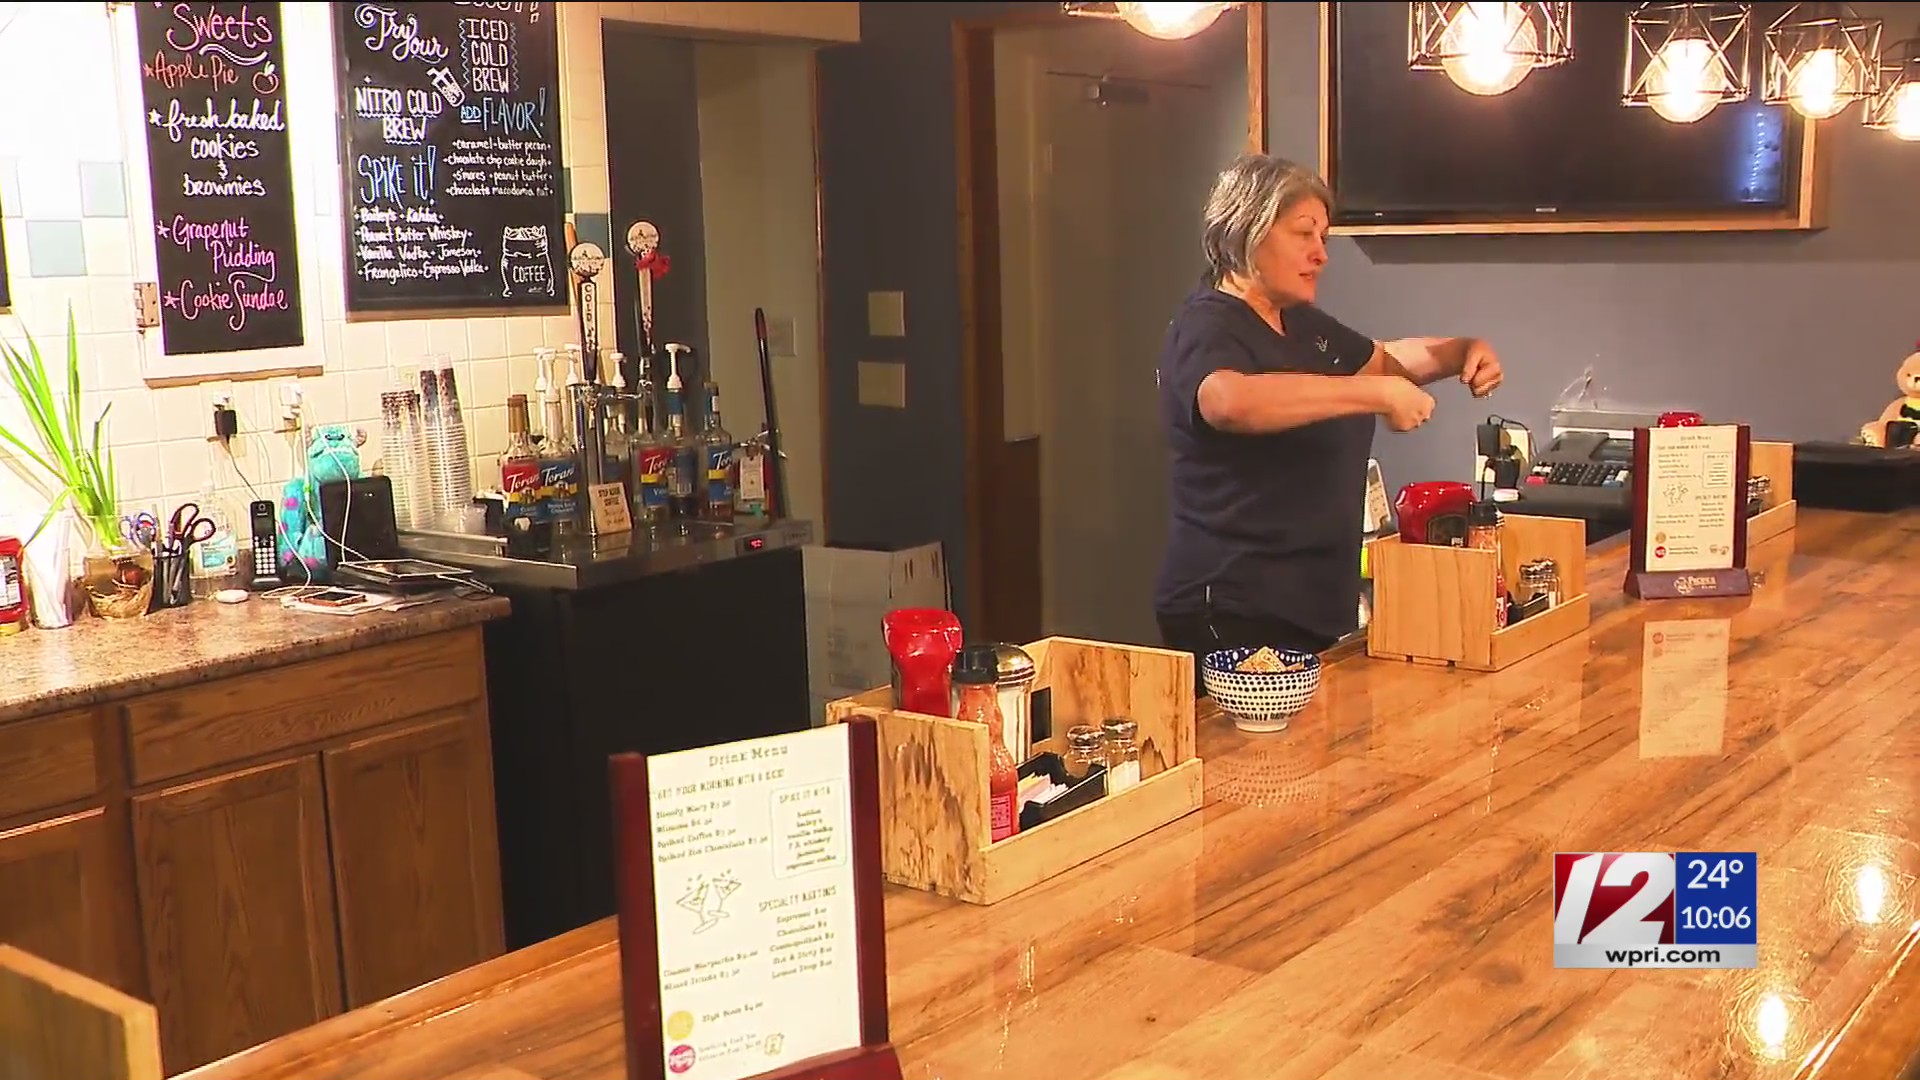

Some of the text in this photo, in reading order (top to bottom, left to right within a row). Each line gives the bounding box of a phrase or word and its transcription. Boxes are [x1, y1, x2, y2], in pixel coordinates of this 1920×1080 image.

[166, 3, 273, 51] Sweets
[354, 3, 417, 61] Try
[411, 37, 449, 59] our
[465, 18, 509, 41] ICED
[471, 41, 509, 67] COLD
[153, 50, 239, 92] Apple Pie
[472, 68, 510, 93] BREW
[355, 87, 442, 115] NITRO COLD
[460, 105, 482, 119] ADD
[160, 98, 285, 142] fresh baked
[383, 117, 427, 140] BREW
[191, 132, 260, 160] cookies
[456, 136, 547, 155] caramel butter pecan
[183, 172, 266, 198] brownies
[494, 170, 519, 185] peanut
[171, 213, 249, 251] Grapenut
[211, 241, 276, 283] Pudding
[512, 264, 546, 283] COFFEE
[179, 278, 232, 321] Cookie
[708, 745, 788, 768] Drink Menu
